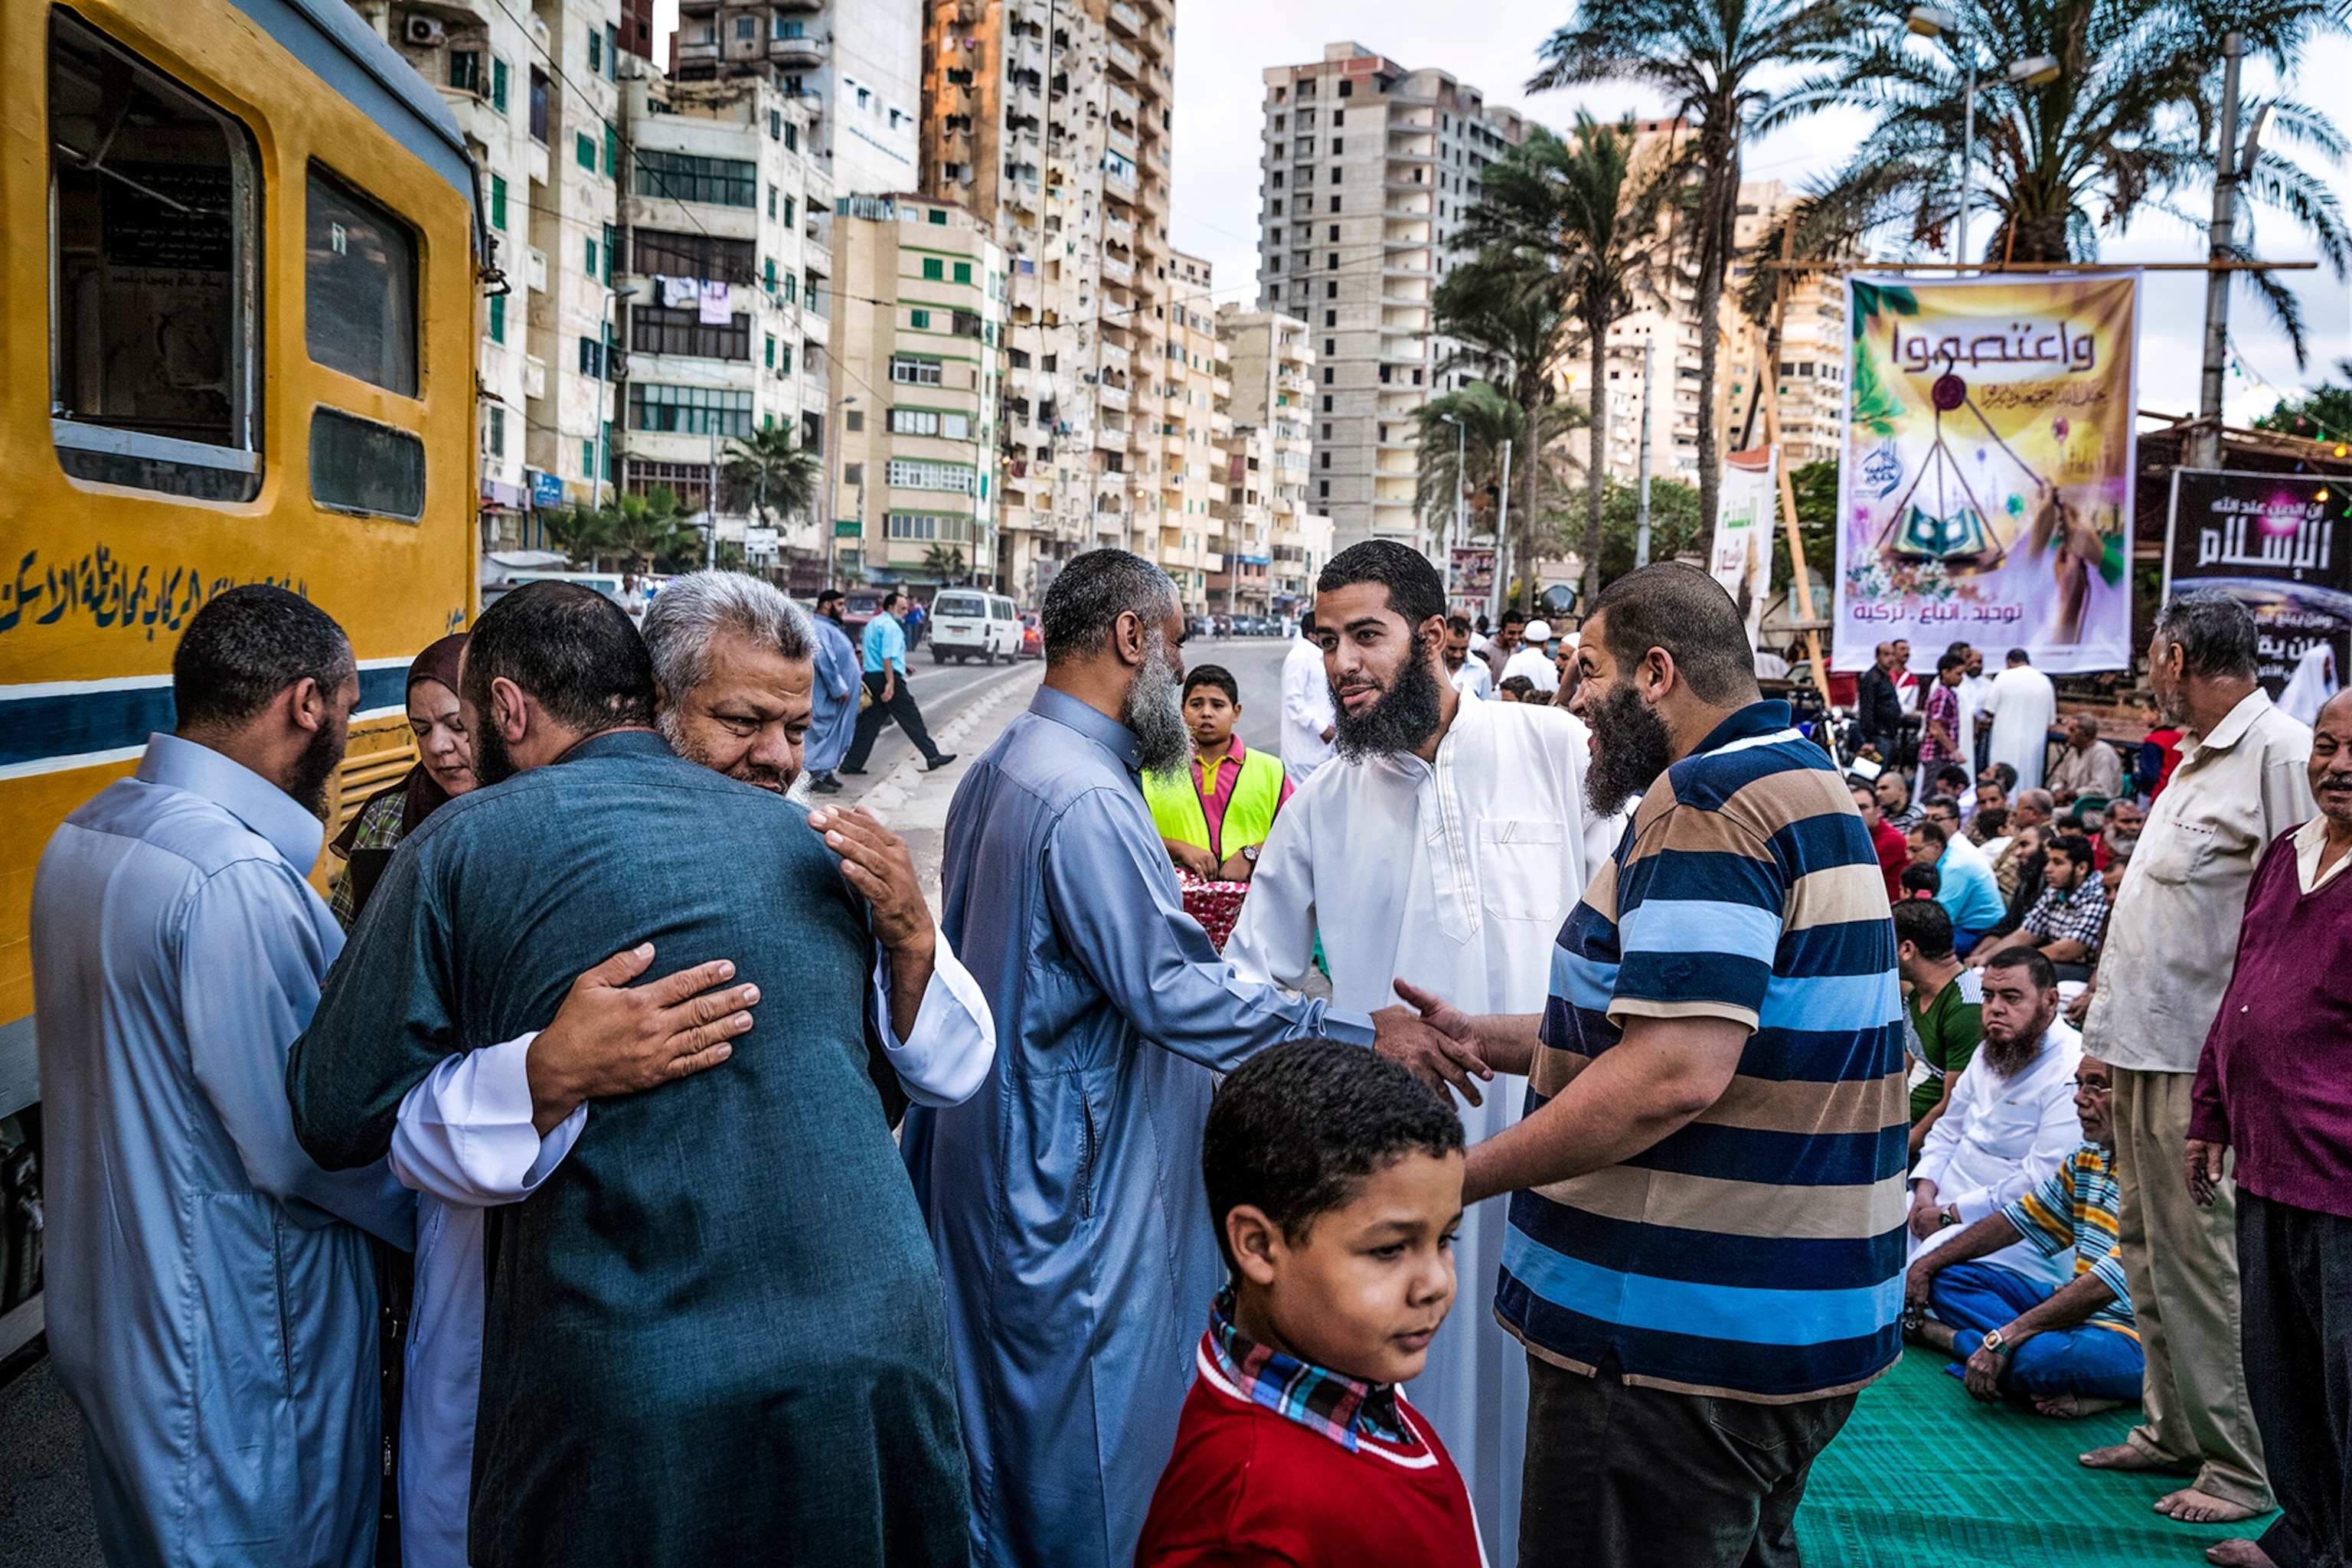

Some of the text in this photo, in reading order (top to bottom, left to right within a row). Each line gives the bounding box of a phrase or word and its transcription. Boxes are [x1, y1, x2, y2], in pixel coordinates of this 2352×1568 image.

[1893, 322, 2095, 373] واعتصموا
[2211, 495, 2240, 514] الله
[2196, 514, 2334, 580] الإسلام
